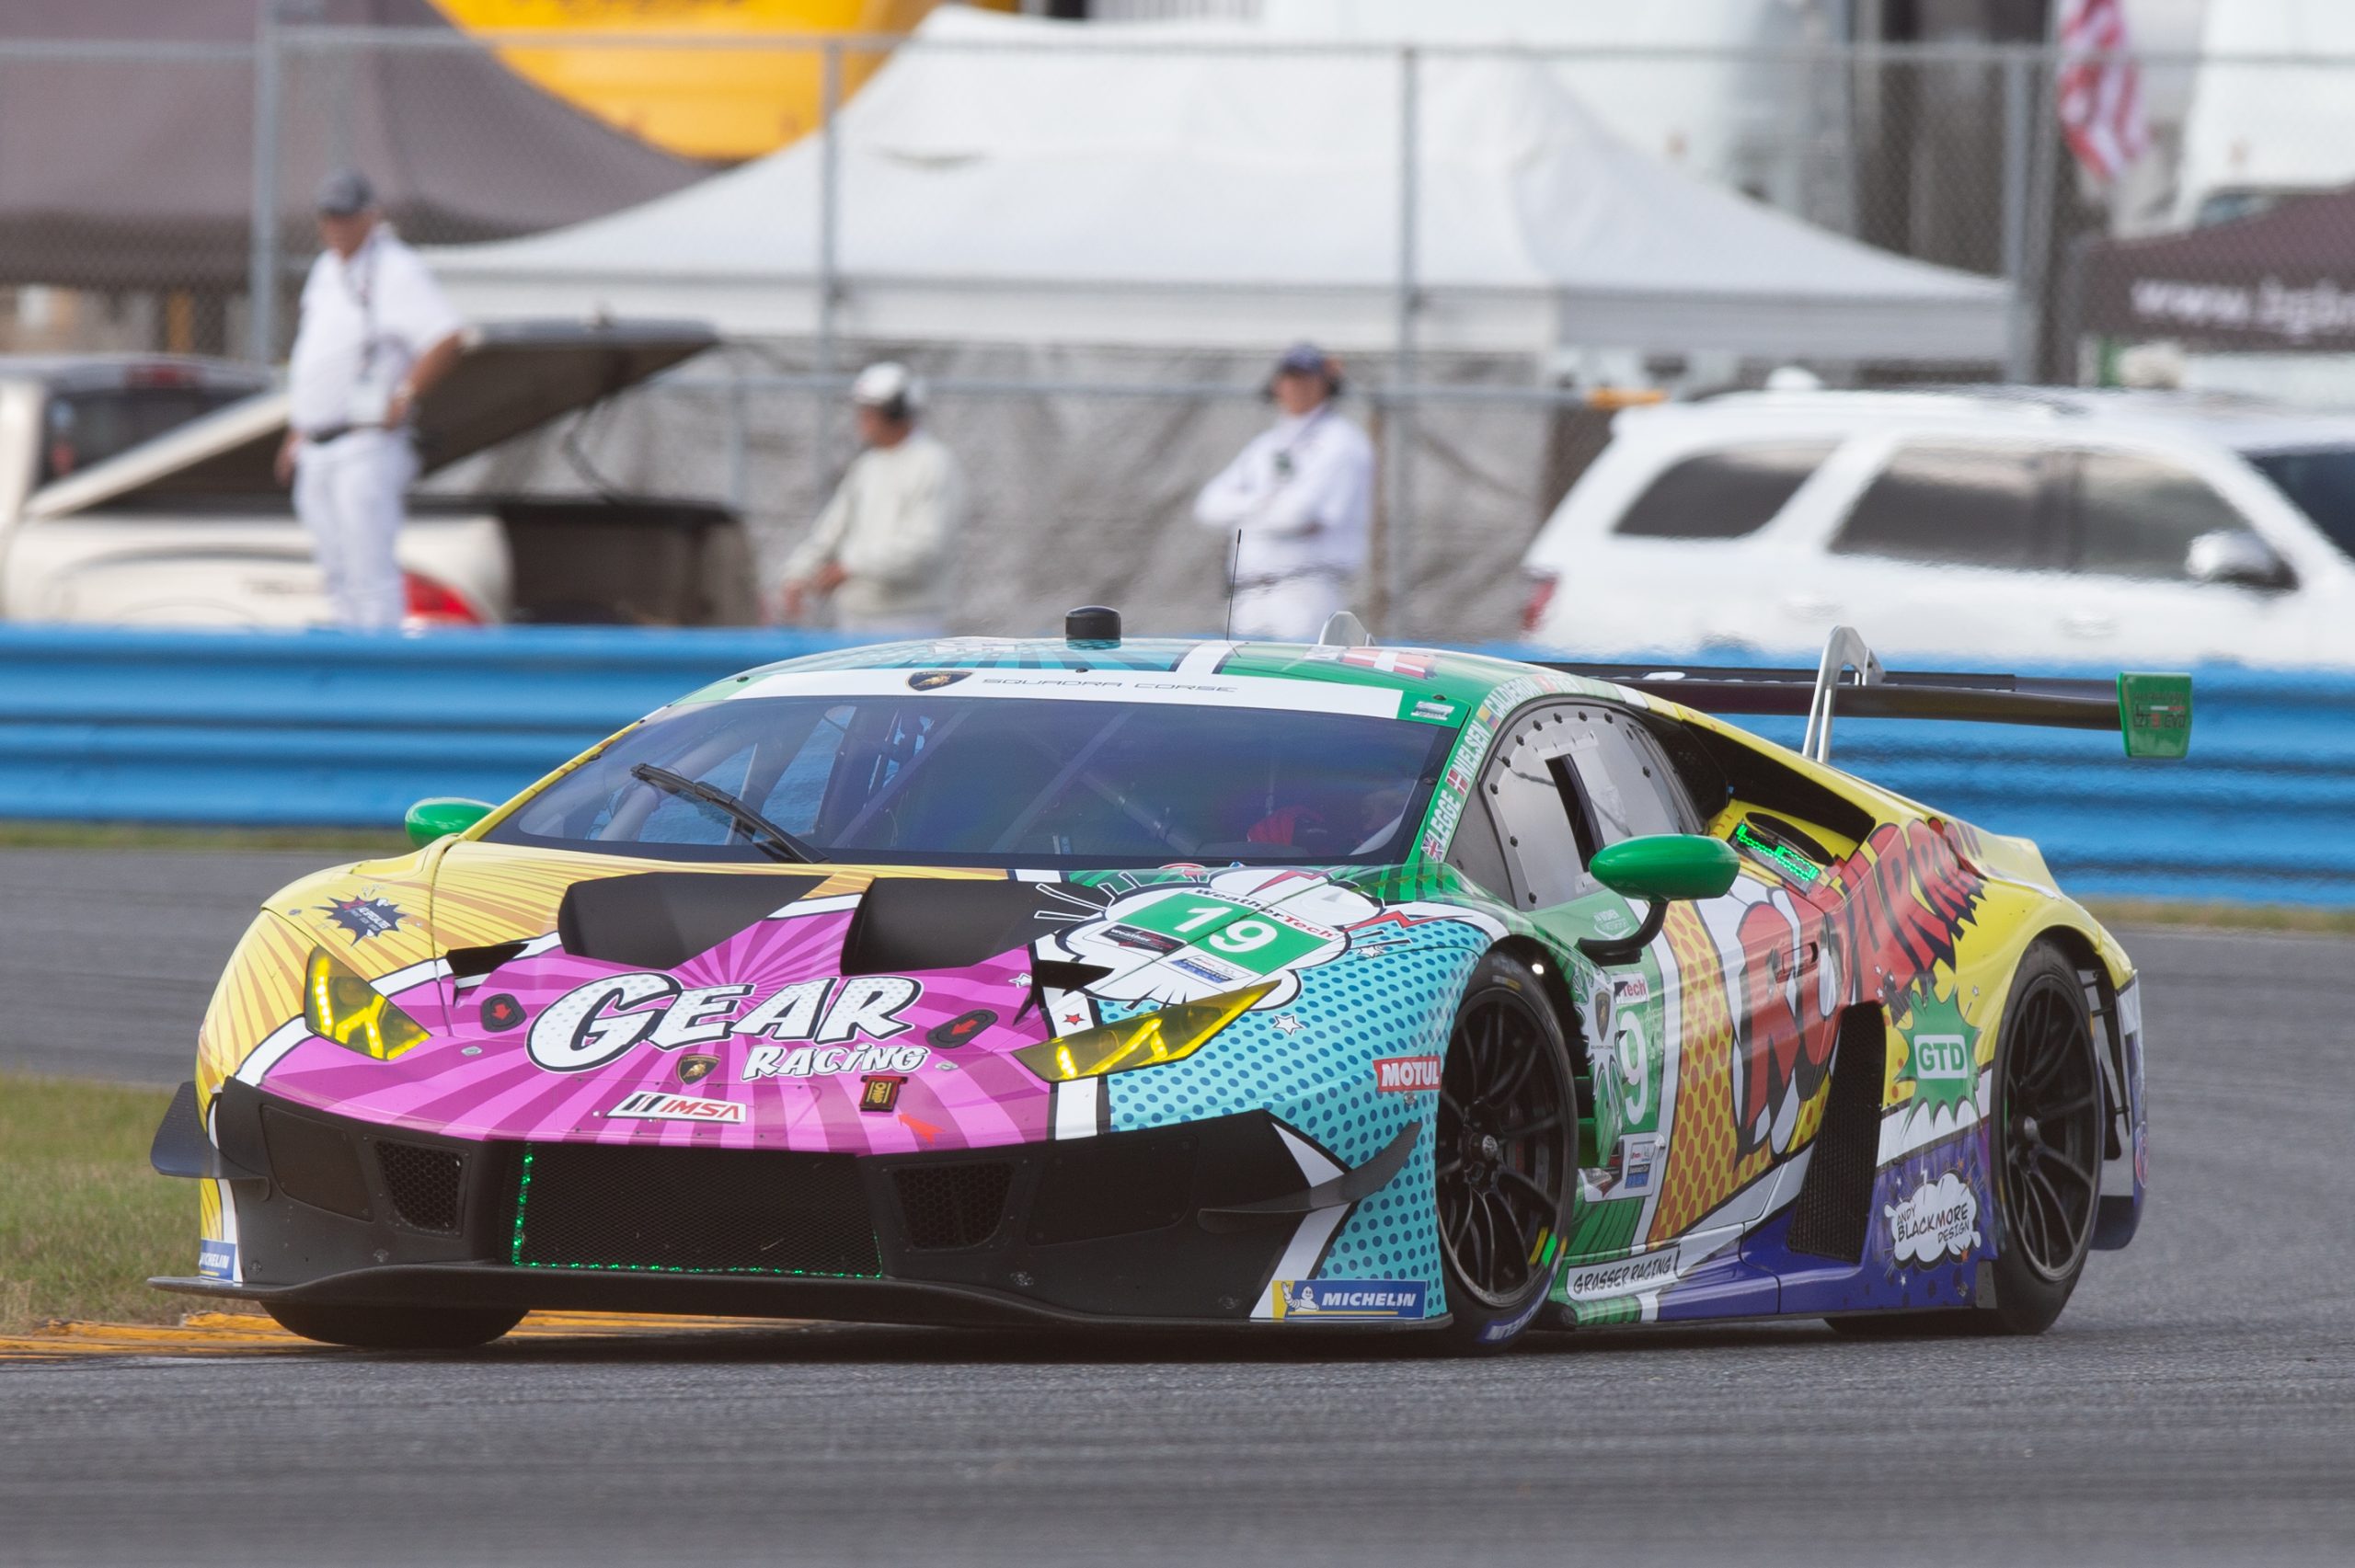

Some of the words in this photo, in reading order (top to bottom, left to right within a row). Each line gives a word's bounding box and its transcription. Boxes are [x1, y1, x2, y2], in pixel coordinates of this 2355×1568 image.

[982, 678, 1122, 688] SQUADRA
[1134, 683, 1237, 692] CORSE
[1451, 720, 1491, 782] NIELSEN
[1427, 790, 1461, 847] LEGGE
[1175, 906, 1278, 953] 19
[1196, 888, 1334, 938] WeatherTech
[528, 972, 923, 1072] GEAR
[1381, 1060, 1440, 1087] MOTUL
[1917, 1041, 1965, 1072] GTD
[657, 1099, 740, 1120] IMSA
[1897, 1204, 1916, 1226] ANDY
[1898, 1202, 1969, 1242] BLACKMORE
[1937, 1219, 1970, 1244] DESIGN
[1573, 1265, 1630, 1295] GRASSER
[1630, 1254, 1672, 1284] RACING
[1321, 1292, 1417, 1307] MICHELIN
